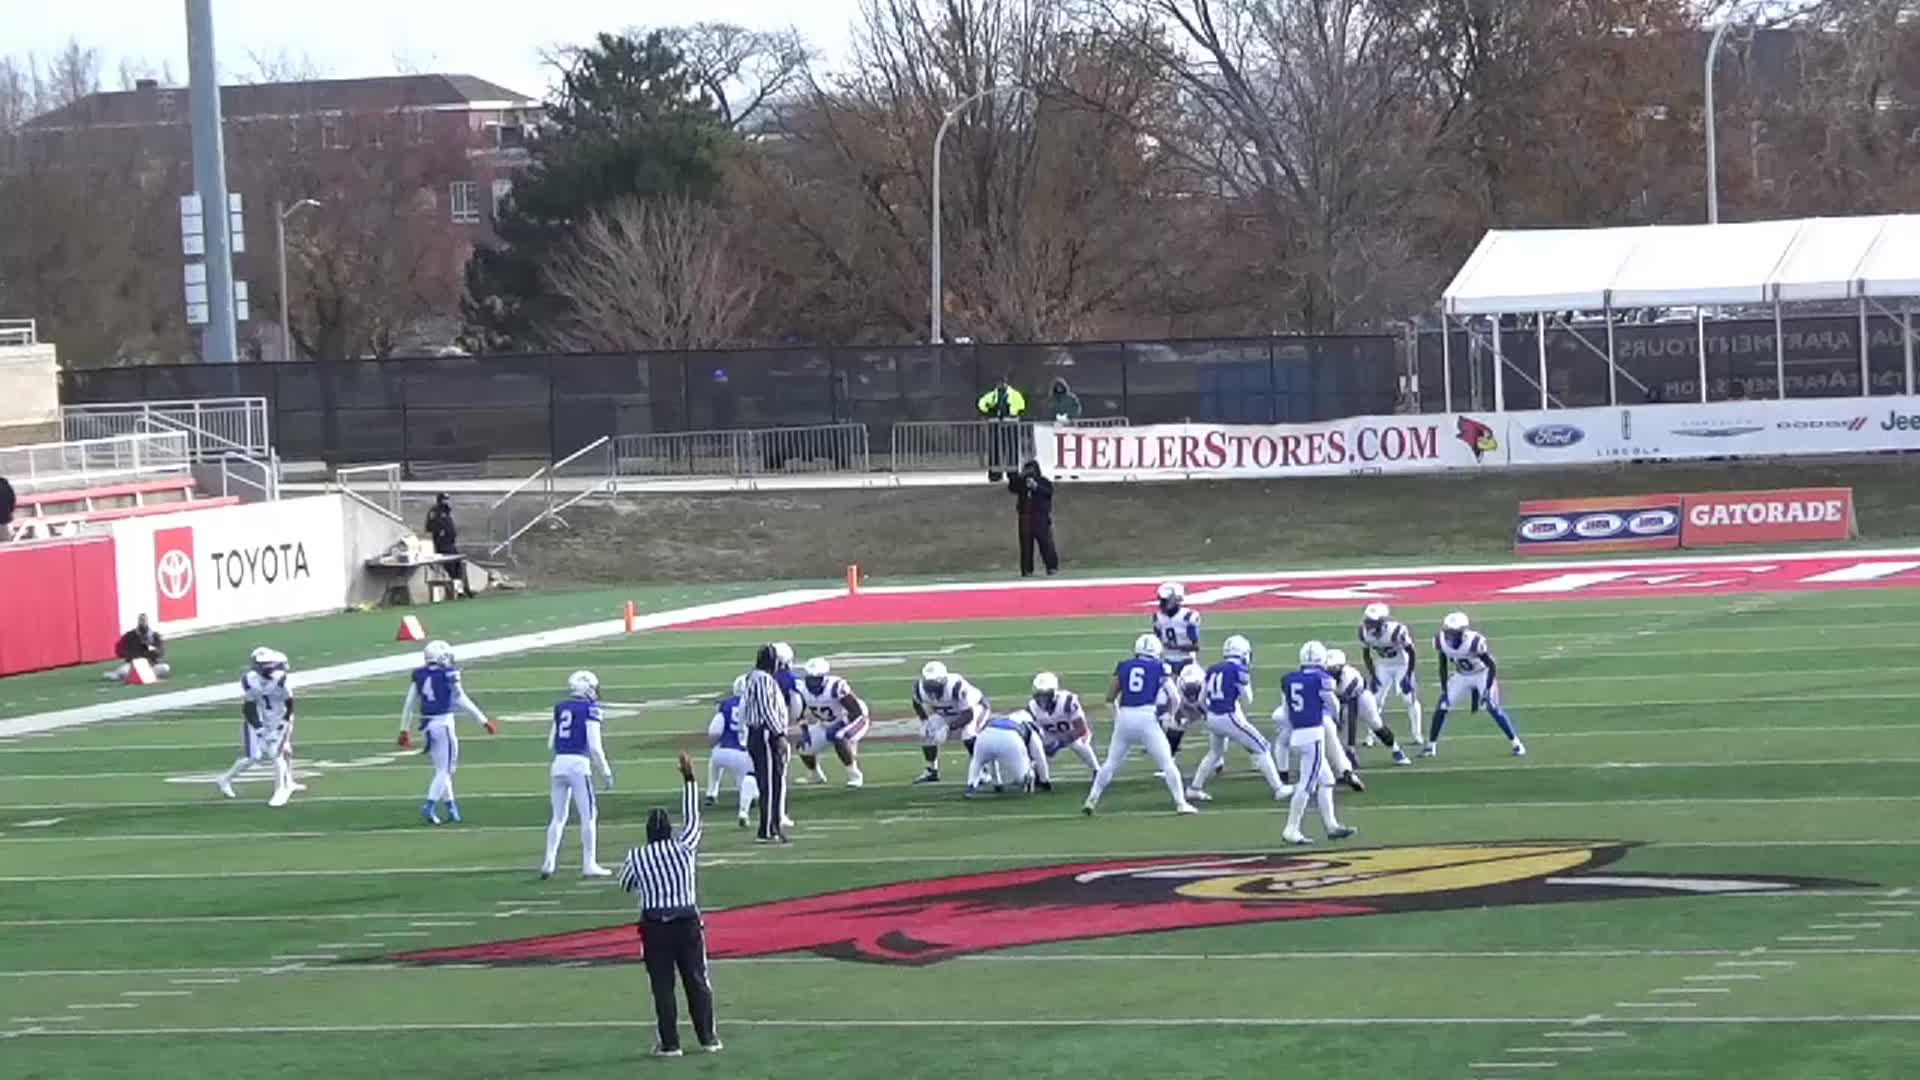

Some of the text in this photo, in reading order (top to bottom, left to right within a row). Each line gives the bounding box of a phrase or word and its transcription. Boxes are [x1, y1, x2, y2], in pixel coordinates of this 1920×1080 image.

[1533, 425, 1574, 445] Ford
[1689, 499, 1842, 528] GATORADE
[210, 541, 311, 591] TOYOTA
[421, 675, 437, 702] 4
[1128, 666, 1146, 693] 6
[1289, 682, 1306, 713] 5
[558, 709, 574, 739] 2
